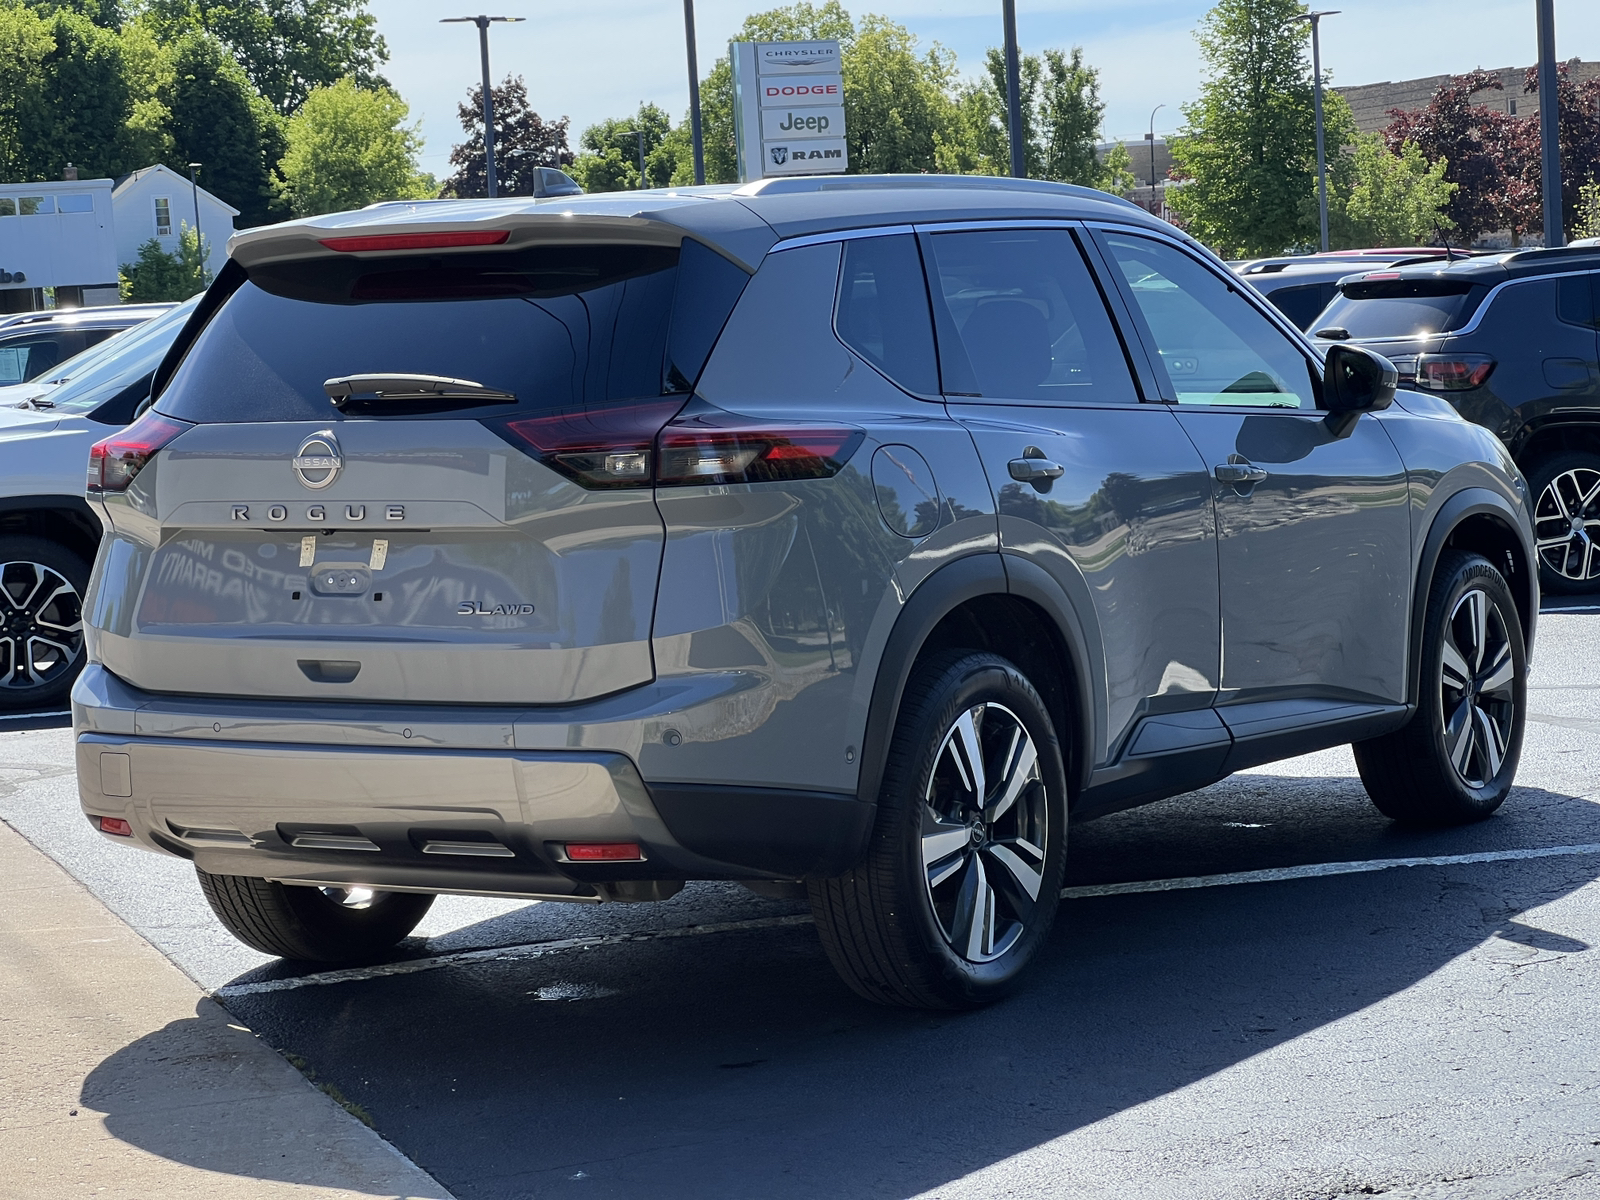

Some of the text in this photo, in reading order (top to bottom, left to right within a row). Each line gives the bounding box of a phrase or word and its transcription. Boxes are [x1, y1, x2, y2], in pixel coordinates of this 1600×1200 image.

[766, 48, 833, 57] CHRYSLER
[766, 85, 838, 96] DODGE
[779, 112, 829, 133] Jeep
[792, 149, 842, 160] RAM
[293, 457, 341, 467] NISSAN
[231, 504, 405, 521] ROGUE
